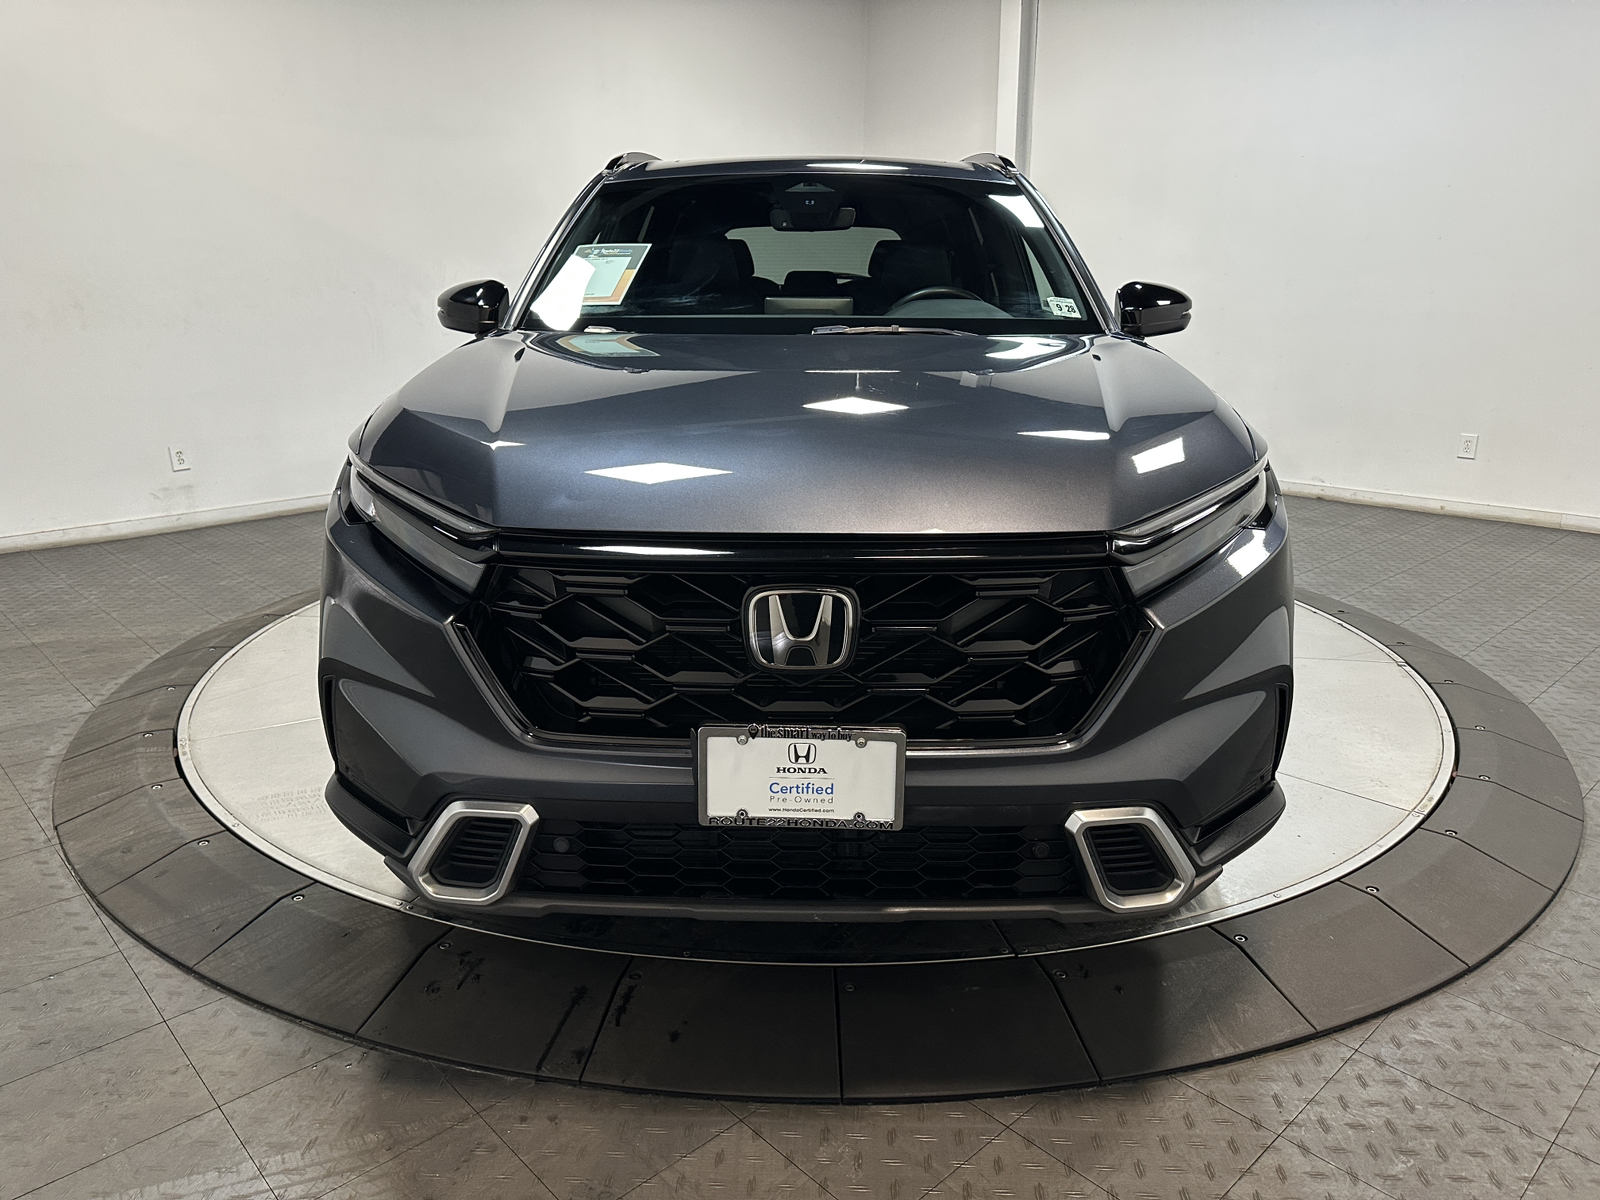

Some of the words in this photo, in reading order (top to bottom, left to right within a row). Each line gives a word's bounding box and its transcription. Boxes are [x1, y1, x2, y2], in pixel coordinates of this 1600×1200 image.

[1056, 304, 1062, 312] 9
[760, 724, 776, 738] the
[777, 726, 809, 740] smart
[811, 731, 827, 741] way
[828, 729, 837, 740] to
[837, 728, 853, 742] buy
[775, 766, 828, 775] HONDA
[769, 781, 834, 795] Certified
[769, 795, 834, 804] Pre-Owned
[708, 816, 894, 830] ROUTE22HONDA.COM
